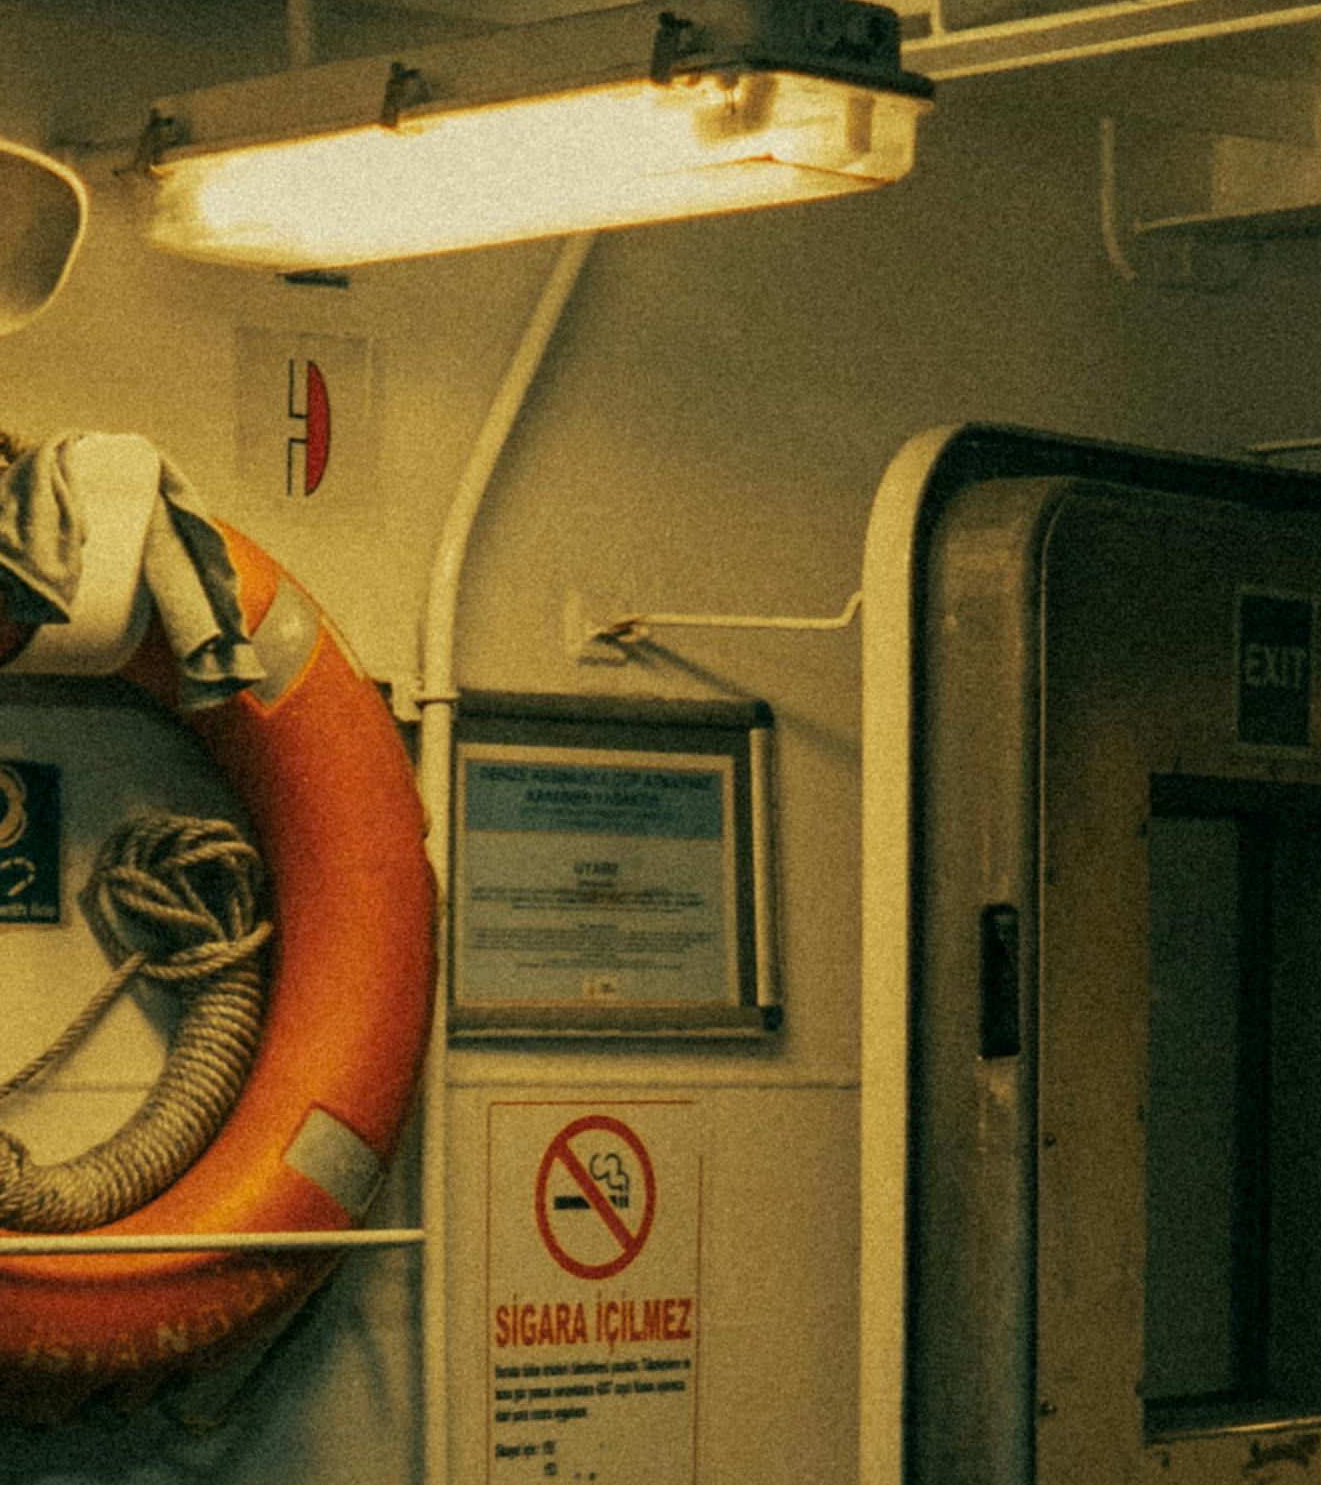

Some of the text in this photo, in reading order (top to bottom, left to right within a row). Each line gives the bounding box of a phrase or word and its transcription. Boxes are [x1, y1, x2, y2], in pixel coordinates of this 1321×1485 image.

[1245, 642, 1308, 690] EXIT
[495, 1289, 692, 1354] SİGARA İÇİLMEZ
